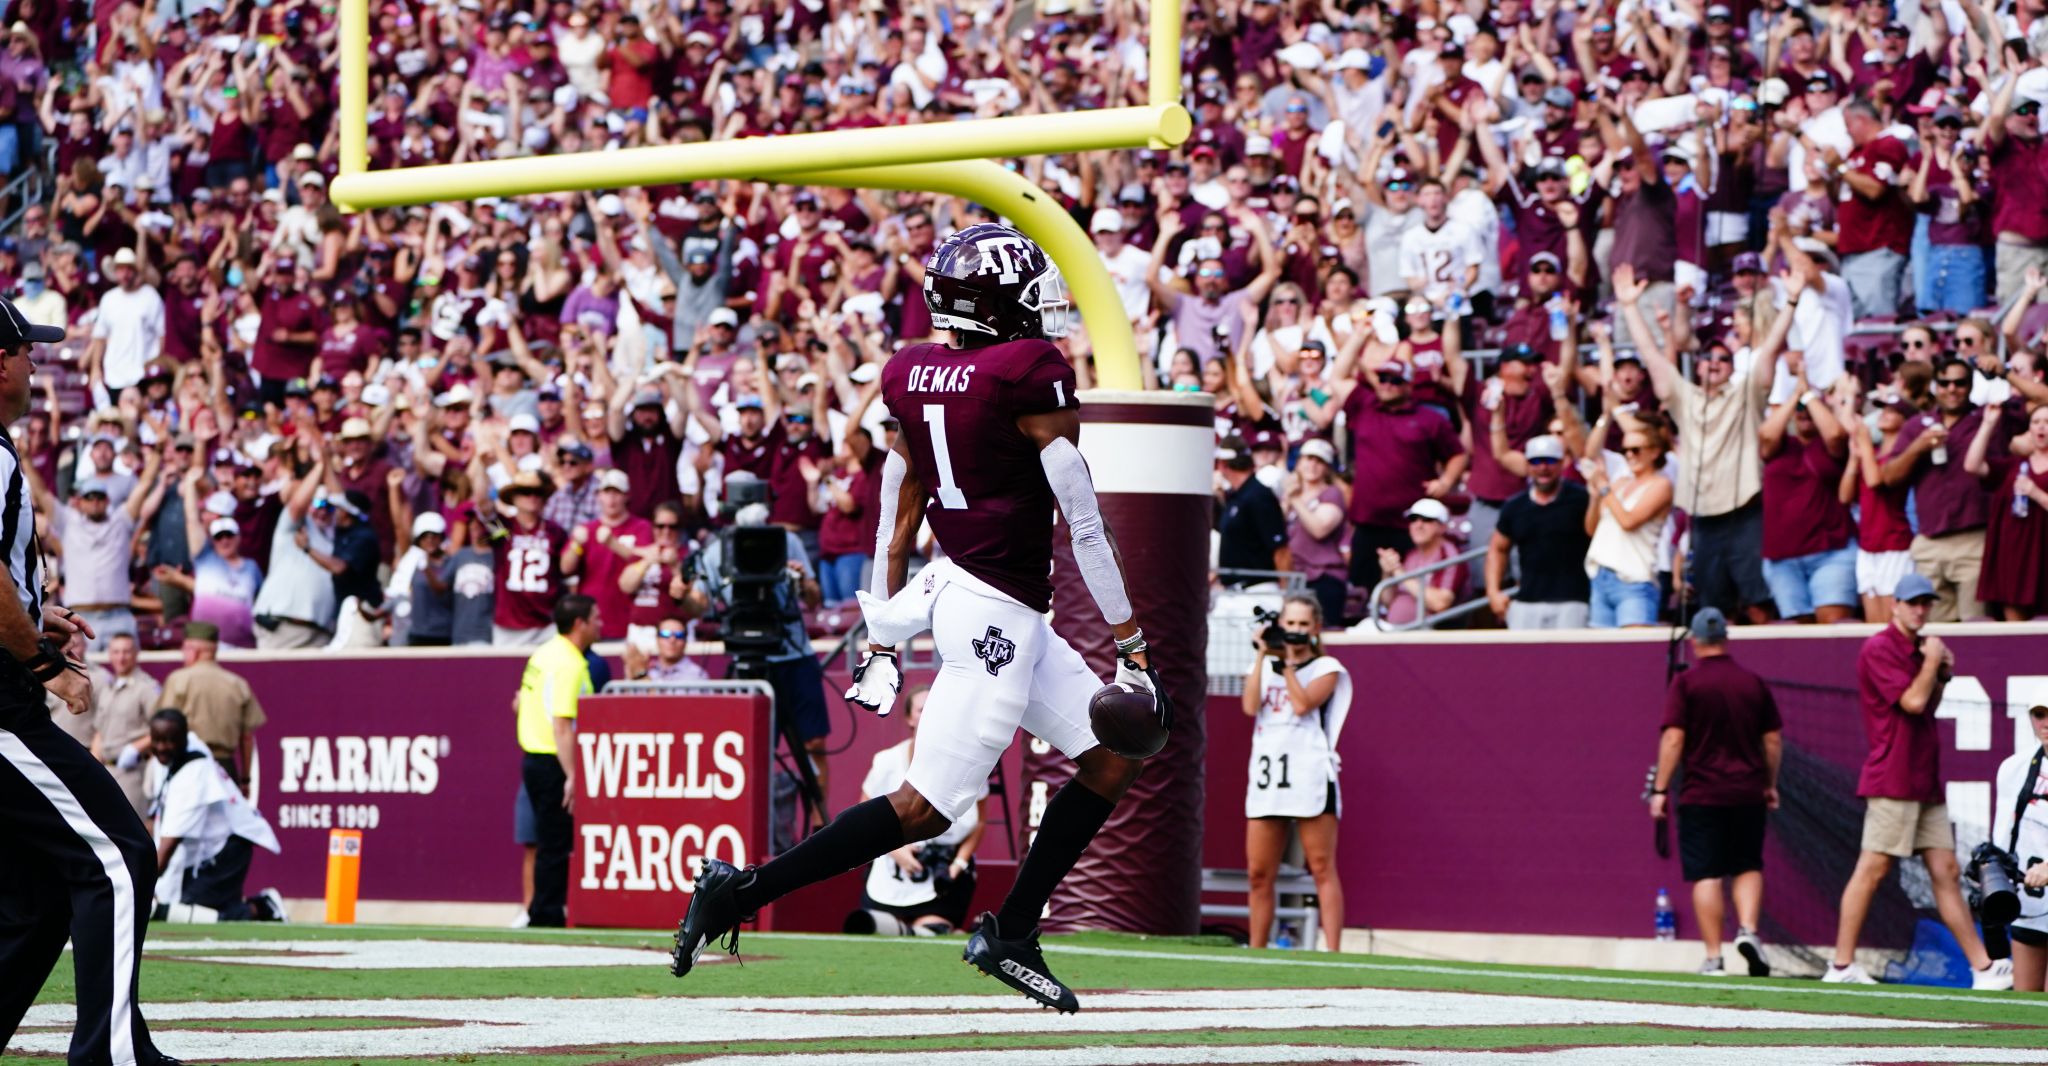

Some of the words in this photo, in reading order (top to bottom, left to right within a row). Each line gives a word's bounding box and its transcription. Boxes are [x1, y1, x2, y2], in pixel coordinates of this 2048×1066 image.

[1420, 250, 1454, 283] 12
[907, 365, 976, 393] DEMAS
[1053, 380, 1066, 407] 1
[922, 404, 969, 509] 1
[506, 549, 549, 592] 12
[577, 731, 745, 800] WELLS
[1257, 754, 1291, 790] 31
[279, 804, 332, 828] SINCE
[337, 805, 380, 829] 1909
[580, 823, 746, 893] FARGO
